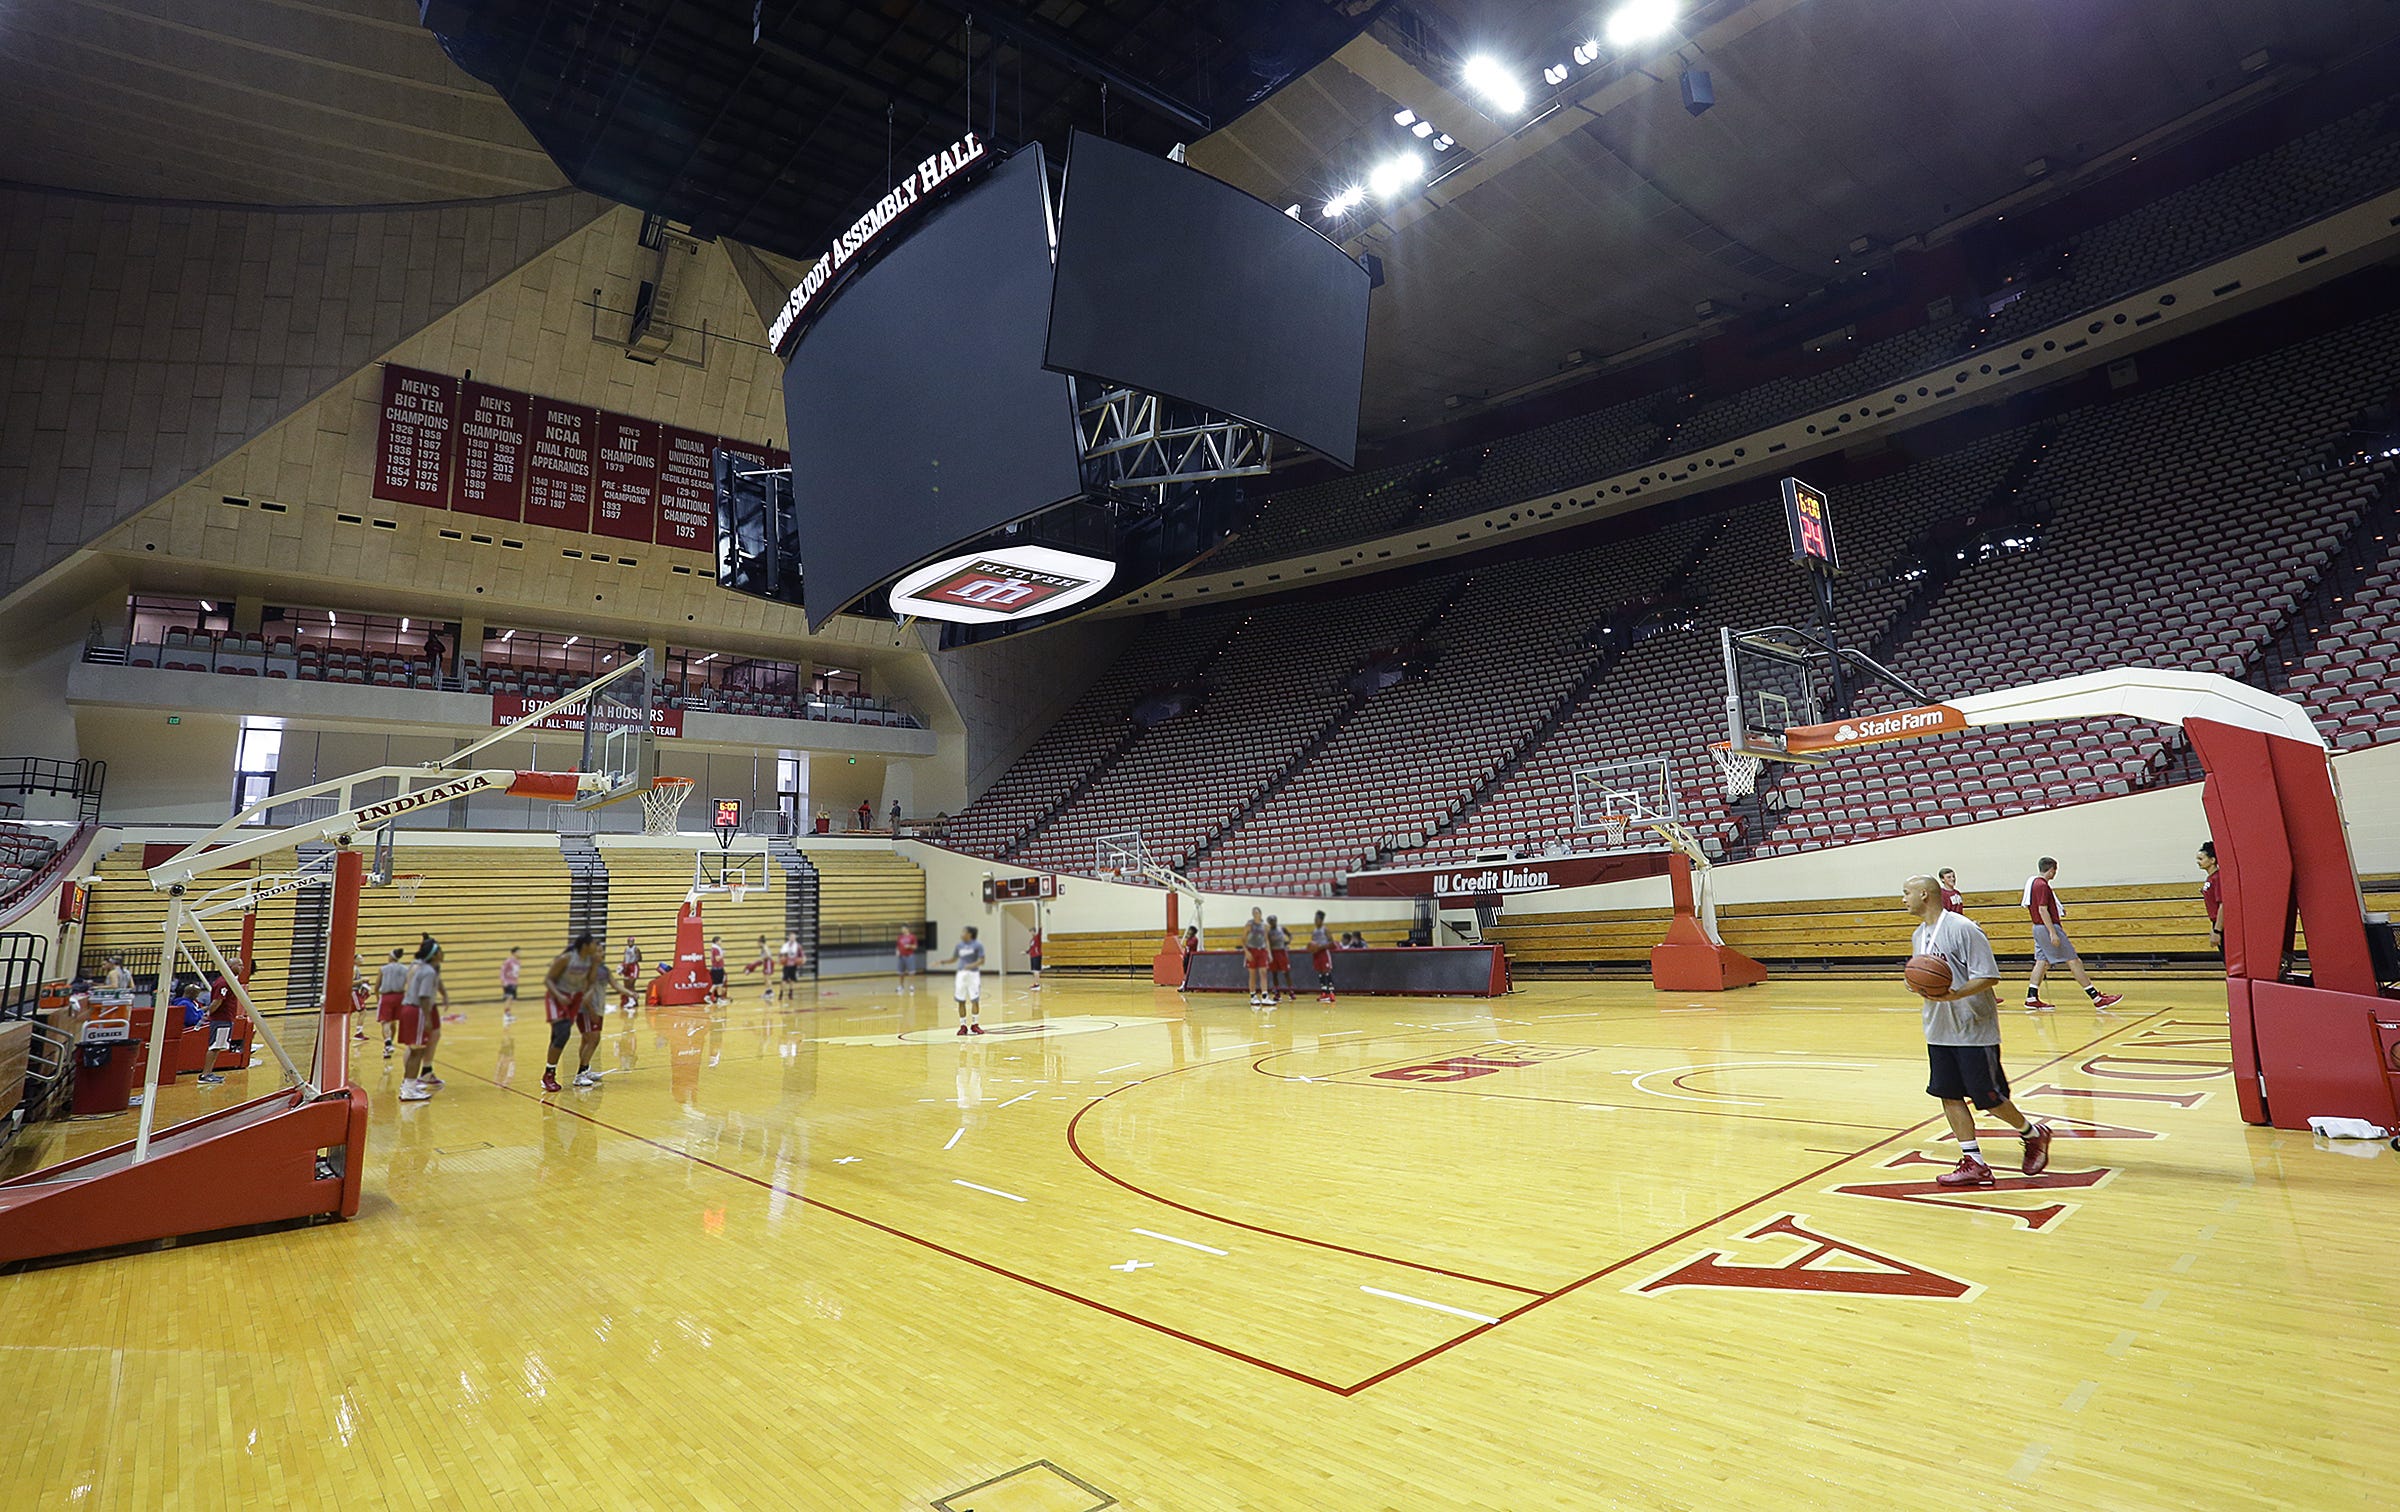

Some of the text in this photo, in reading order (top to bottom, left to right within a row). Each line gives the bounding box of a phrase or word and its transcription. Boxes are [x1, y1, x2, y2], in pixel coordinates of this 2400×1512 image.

[768, 132, 984, 354] SIMON SKJODT ASSEMBLY HALL
[401, 379, 440, 398] MEN'S
[394, 393, 444, 414] BIG TEN
[480, 396, 512, 413] MEN'S
[386, 408, 448, 430] CHAMPIONS
[474, 410, 514, 428] BIG TEN
[548, 410, 581, 428] MEN'S
[390, 422, 442, 440] 1926 1958
[462, 422, 522, 445] CHAMPIONS
[546, 426, 580, 445] NCAA
[619, 426, 640, 437] MEN'S
[390, 434, 441, 450] 1928 1967
[468, 438, 516, 454] 1980 1993
[619, 437, 638, 452] NIT
[676, 438, 704, 454] INDIANA
[388, 444, 440, 460] 1936 1973
[467, 448, 514, 464] 1981 2002
[536, 441, 588, 462] FINAL FOUR
[601, 448, 655, 468] CHAMPIONS
[669, 450, 710, 468] UNIVERSITY
[388, 454, 440, 471] 1953 1974
[466, 458, 514, 474] 1983 2013
[532, 455, 589, 476] APPEARANCES
[386, 465, 438, 482] 1954 1975
[493, 472, 512, 482] 2016
[669, 464, 708, 479] UNDEFEATED
[386, 476, 438, 492] 1957 1976
[464, 478, 486, 490] 1989
[602, 480, 615, 490] PRE
[622, 484, 650, 496] SEASON
[662, 473, 714, 490] REGULAR SEASON
[464, 488, 484, 500] 1991
[604, 490, 646, 504] CHAMPIONS
[602, 501, 621, 510] 1993
[662, 495, 711, 514] UPI NATIONAL
[1798, 492, 1821, 520] 6:00
[664, 510, 708, 527] CHAMPIONS
[676, 524, 695, 538] 1975
[1800, 516, 1826, 557] 24
[976, 564, 1079, 588] HEALTH
[555, 702, 604, 718] NDIANA
[608, 706, 664, 722] HOOSIRS
[546, 718, 584, 730] ALL-TIME
[590, 721, 615, 732] ARCH
[656, 726, 676, 736] TEAM
[354, 776, 491, 824] INDIANA
[720, 802, 738, 811] 6:00
[718, 810, 735, 826] 24
[252, 876, 318, 901] INDIANA
[1434, 868, 1548, 893] IU Credit Union
